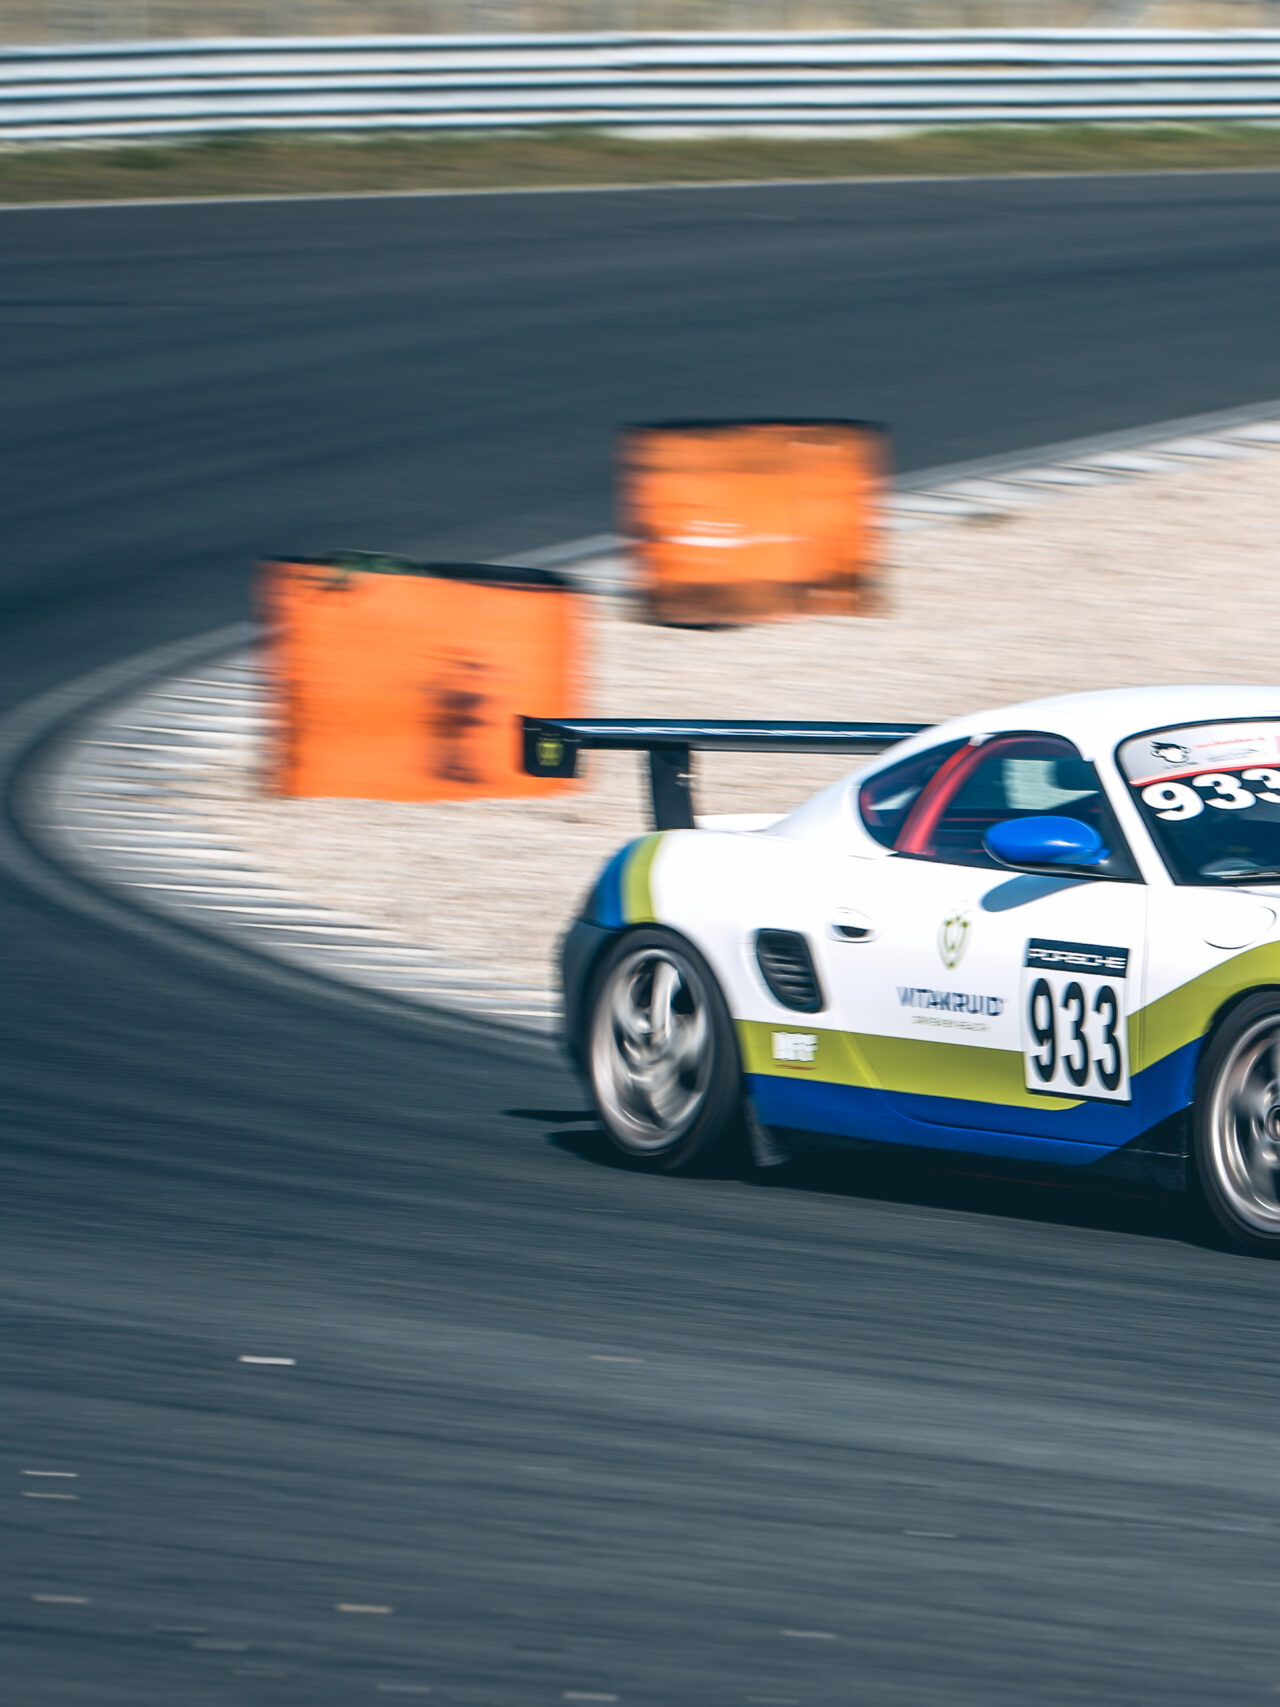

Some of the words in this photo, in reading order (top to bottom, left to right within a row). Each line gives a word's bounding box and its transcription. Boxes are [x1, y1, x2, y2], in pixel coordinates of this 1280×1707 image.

[1028, 948, 1127, 969] PORSCHE
[896, 986, 1004, 1017] VITAKRUID
[1030, 977, 1121, 1091] 933
